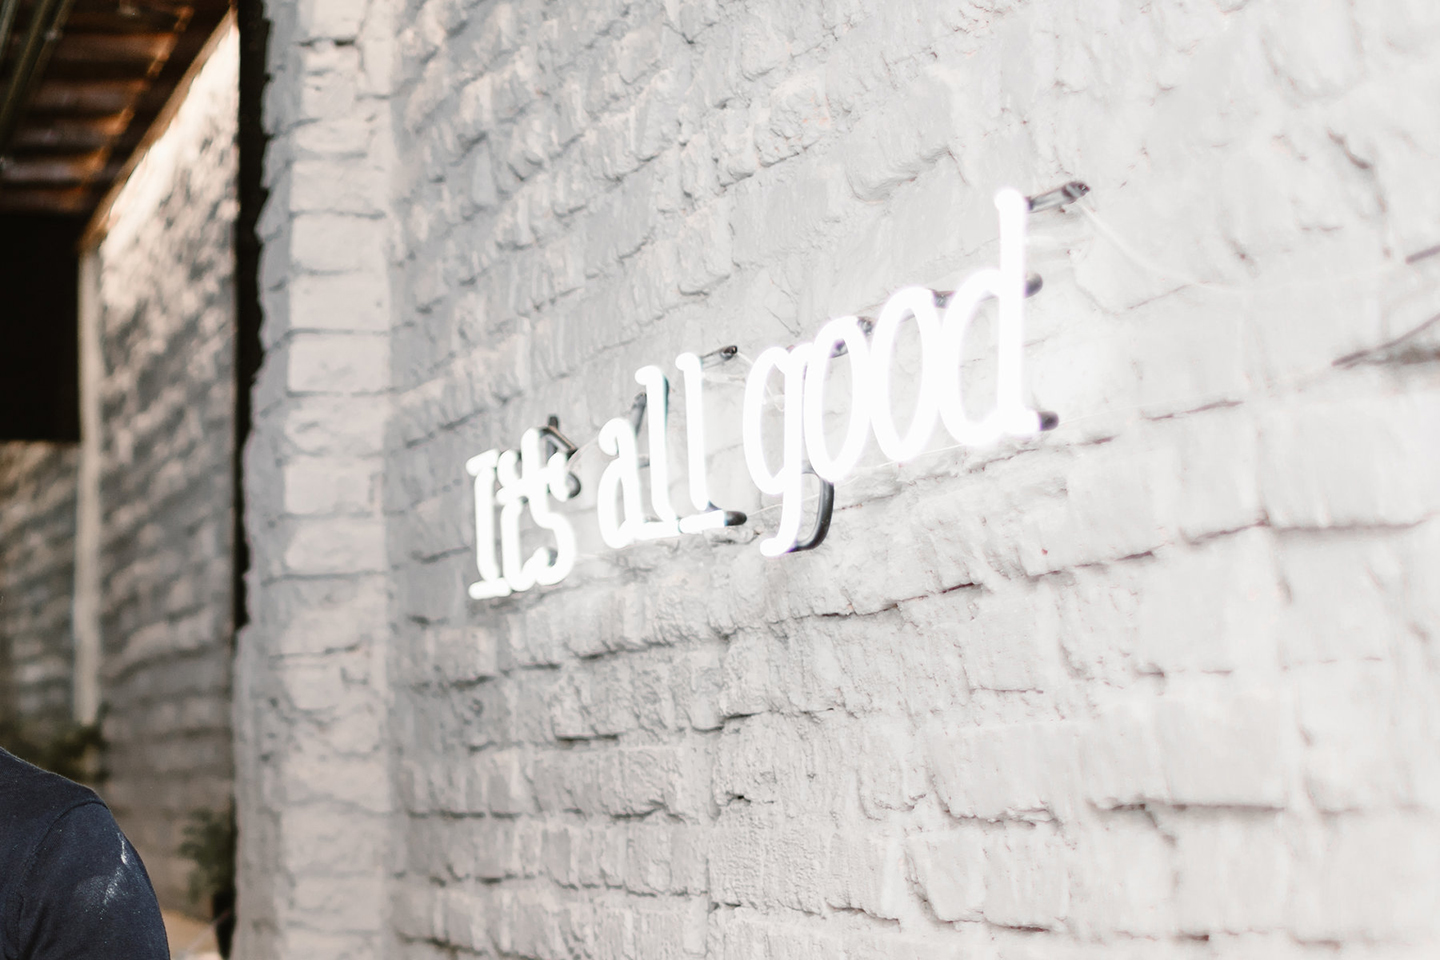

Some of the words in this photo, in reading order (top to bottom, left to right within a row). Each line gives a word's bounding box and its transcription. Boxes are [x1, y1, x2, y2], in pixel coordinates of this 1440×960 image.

[466, 427, 576, 600] It's
[597, 352, 726, 549] all
[742, 187, 1042, 557] good
